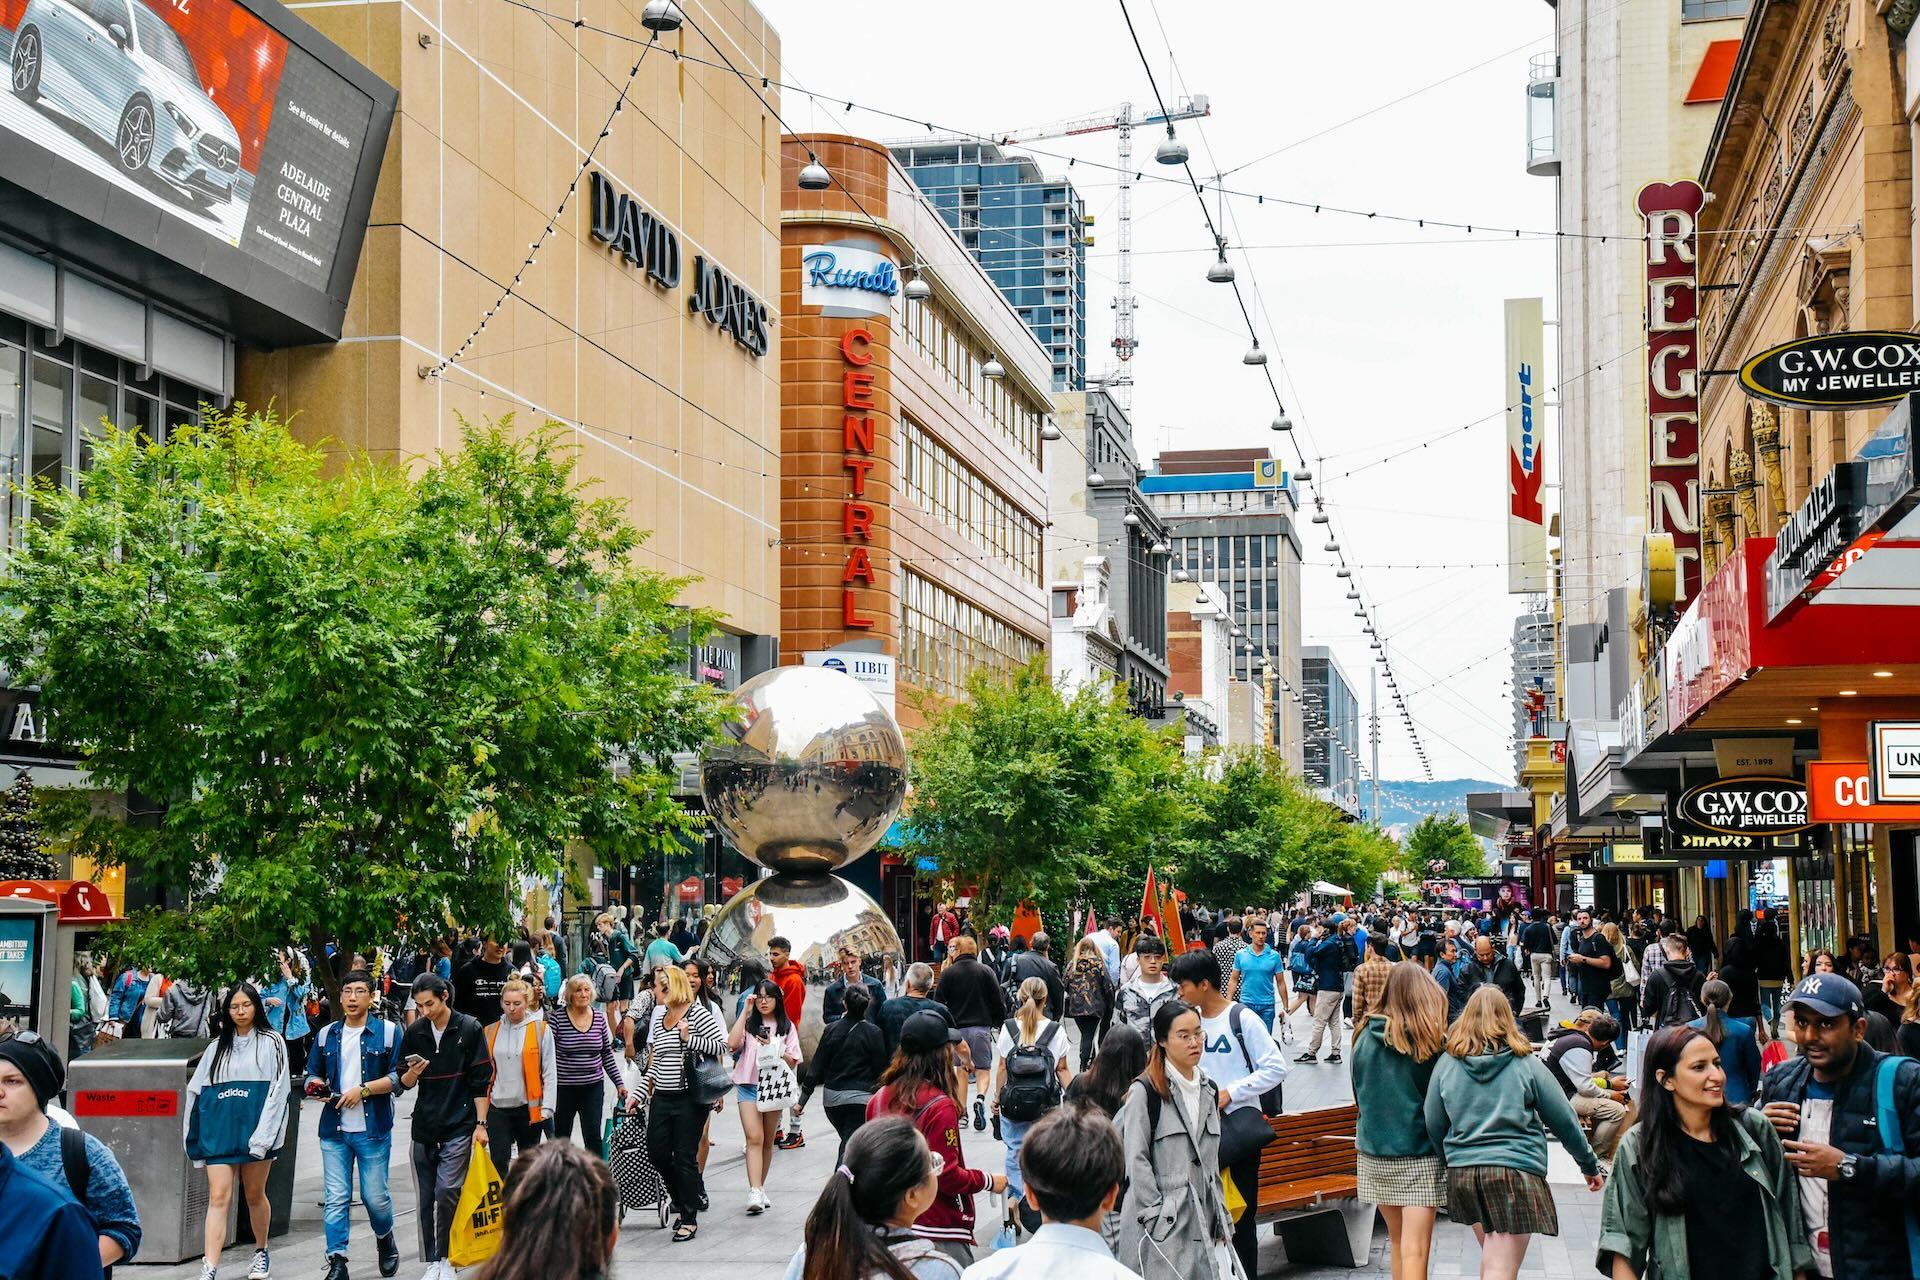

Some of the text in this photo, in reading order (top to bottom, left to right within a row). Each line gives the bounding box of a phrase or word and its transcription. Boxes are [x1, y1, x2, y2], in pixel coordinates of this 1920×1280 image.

[287, 101, 351, 149] See in centre for details
[280, 161, 332, 202] ADELAIDE
[277, 184, 322, 222] CENTRAL
[279, 207, 310, 237] PLAZA
[589, 171, 768, 356] DAVID JONES
[803, 251, 899, 297] Rundle
[1779, 344, 1920, 374] G.W. COX
[1782, 378, 1810, 393] MY
[841, 328, 875, 629] CENTRAL
[716, 647, 736, 671] PINK
[855, 661, 888, 675] IIBIT
[1754, 758, 1773, 766] 1898
[1896, 753, 1920, 767] UN
[1696, 791, 1752, 815] G.W.
[1711, 815, 1806, 828] MY JEWELLER
[1755, 873, 1773, 884] 20
[86, 1093, 116, 1102] Waste
[218, 1088, 249, 1099] adidas
